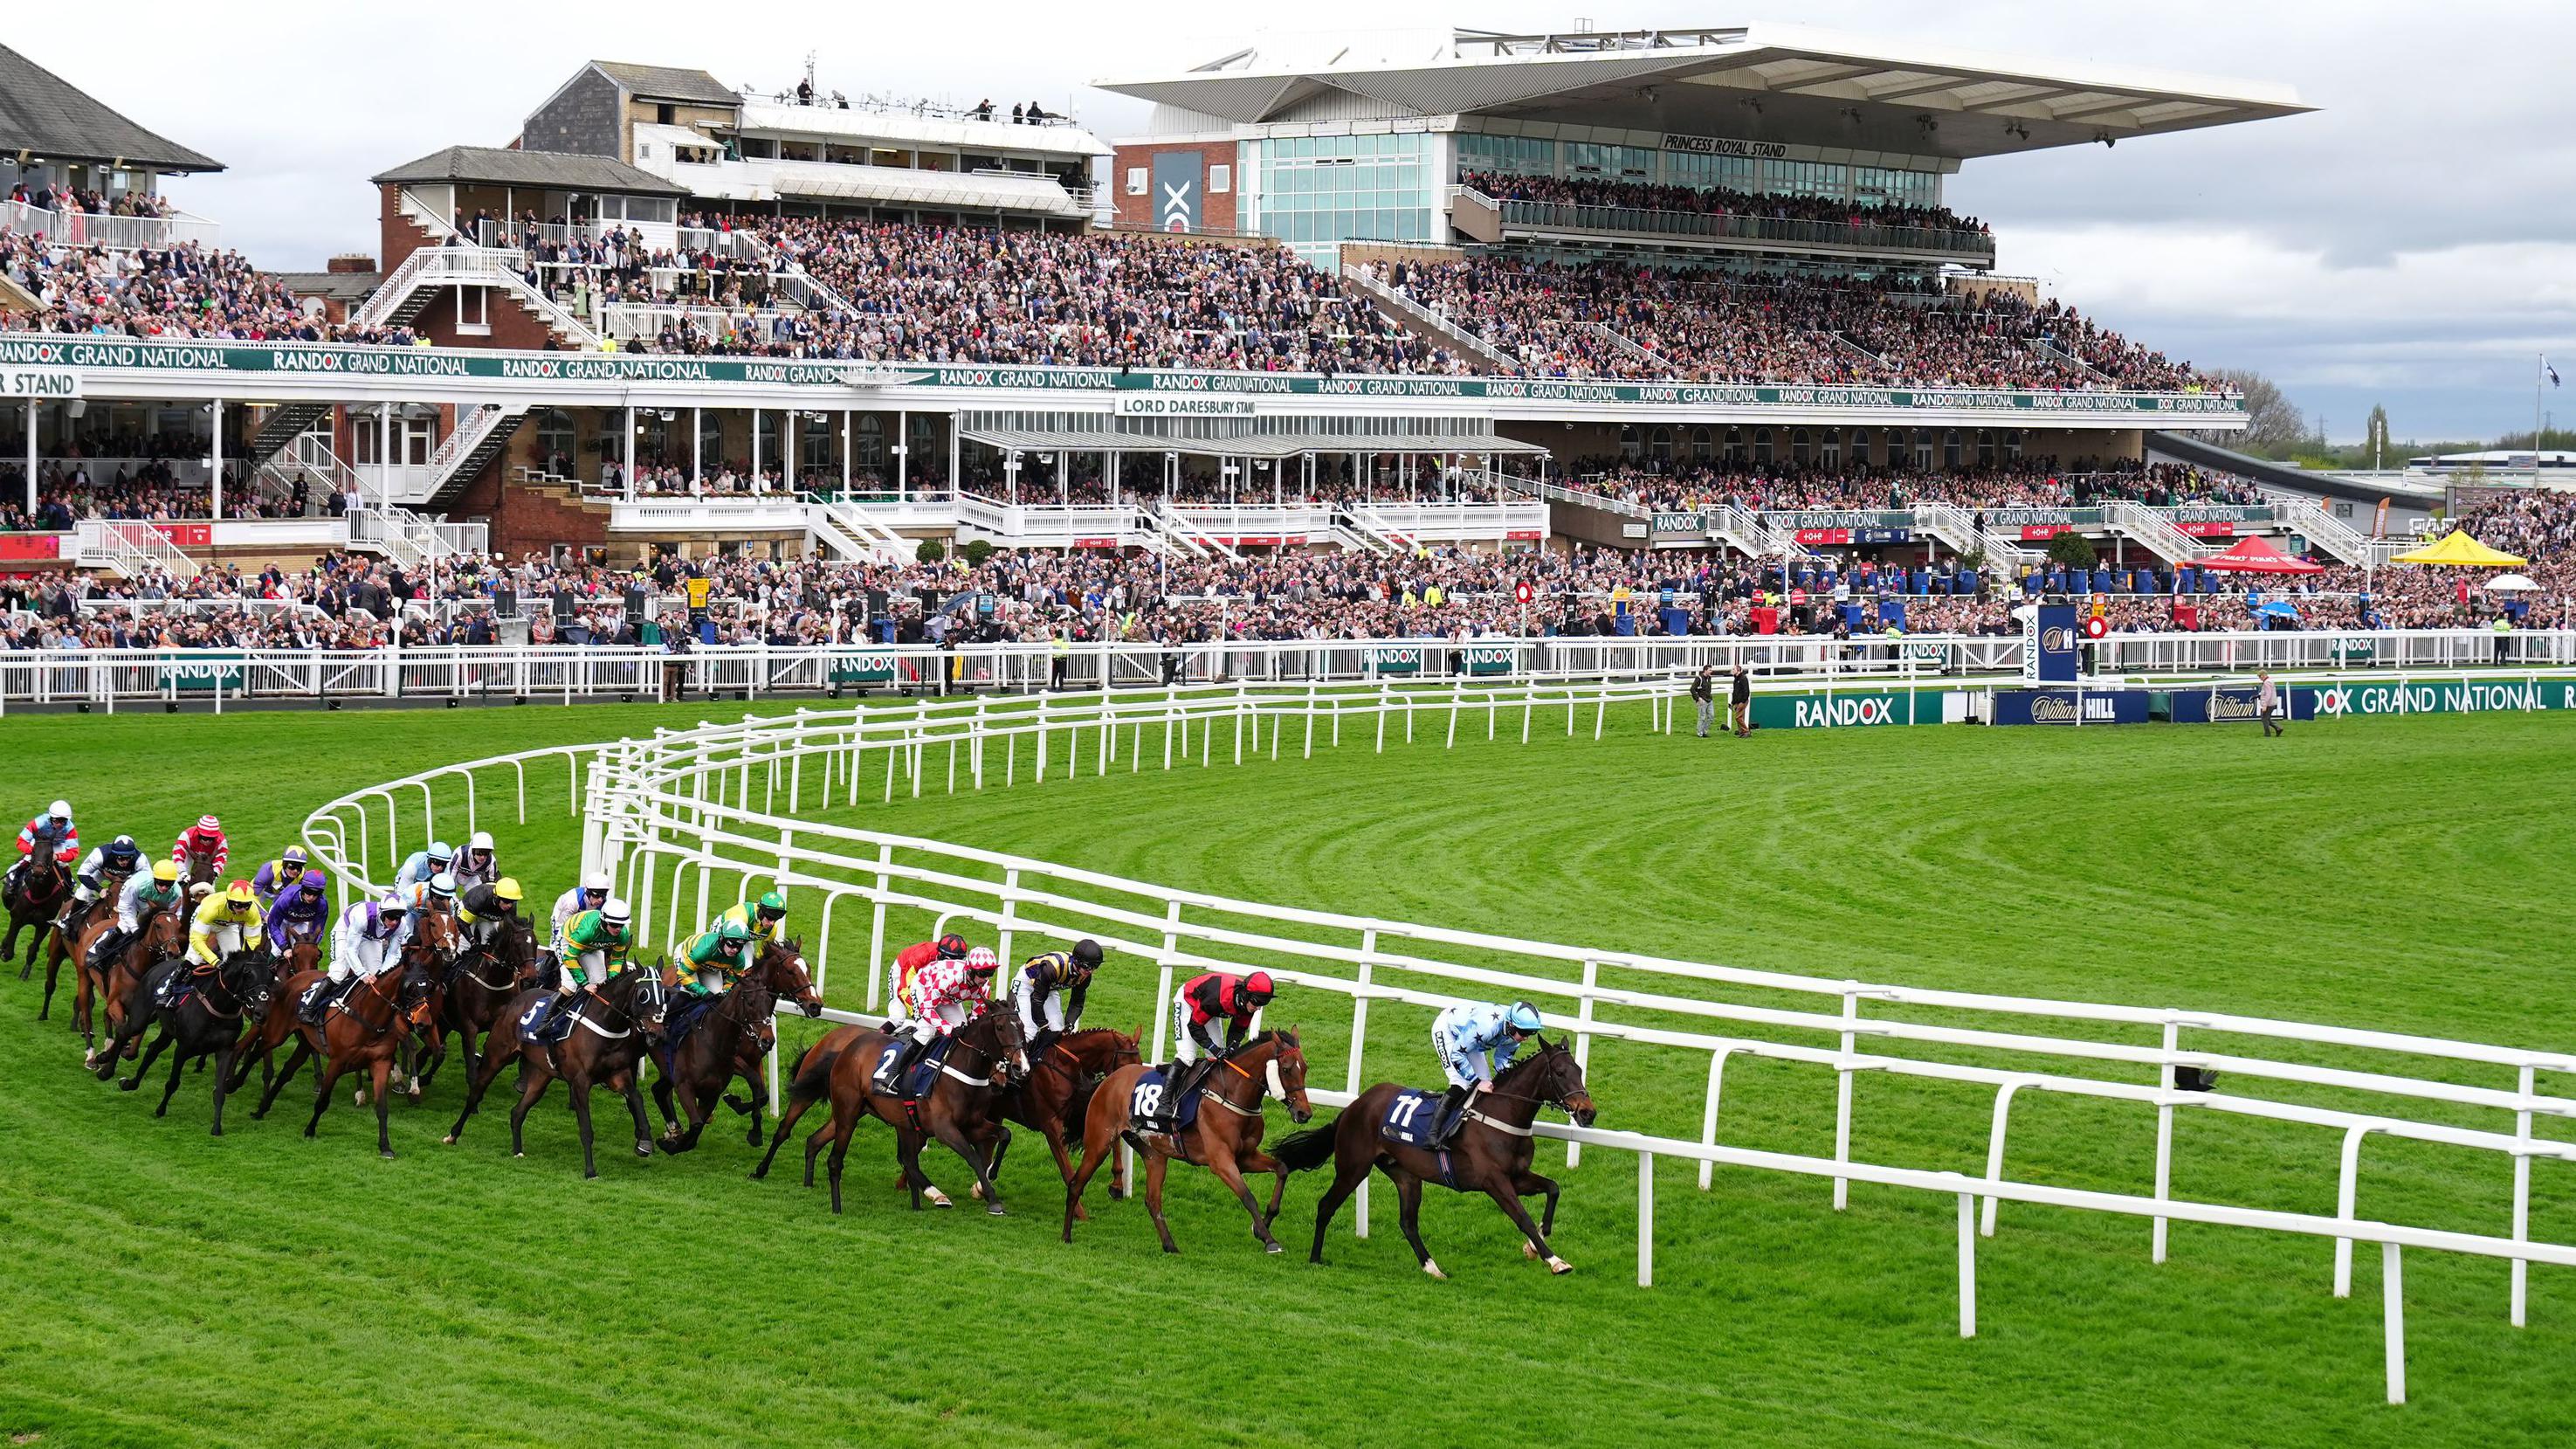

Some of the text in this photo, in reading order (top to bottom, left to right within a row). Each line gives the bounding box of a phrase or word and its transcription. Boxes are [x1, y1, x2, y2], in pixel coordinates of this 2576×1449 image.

[1664, 135, 1787, 158] PRINCESS ROYAL STAND
[72, 344, 135, 366] GRAND
[141, 348, 229, 368] NATIONAL
[273, 352, 469, 376] RANDOX GRAND NATIONAL
[503, 360, 711, 380] RANDOX GRAND NATIONAL
[746, 364, 787, 382] RANDOX
[790, 366, 836, 383] GRAND
[940, 370, 1115, 388] RANDOX GRAND NATIONAL
[15, 373, 74, 395] STAND
[1153, 374, 1292, 393] RANDOX GRAND NATIONAL
[1318, 380, 1462, 396] RANDOX GRAND NATIONAL
[1485, 383, 1618, 400] RANDOX GRAND NATIONAL
[1640, 388, 1678, 401] RANDOX
[1683, 388, 1725, 402] GRAND
[1779, 390, 1893, 404] RANDOX GRAND NATIONAL
[1912, 395, 1954, 406] RANDOX
[1976, 395, 2015, 407] NATIONAL
[2033, 396, 2139, 410] RANDOX GRAND NATIONAL
[1124, 399, 1256, 414] LORD DARESBURY STAND
[2158, 398, 2238, 411] DOX GRAND NATIONAL
[1656, 516, 1699, 530] RANDOX
[1765, 514, 1882, 528] NDOX GRAND NATIONAL
[2000, 512, 2029, 525] GRAND
[2032, 512, 2072, 524] NATIONAL
[2180, 509, 2207, 521] GRAND
[2208, 508, 2245, 521] NATIONAL
[1902, 644, 1946, 657] ANDOX
[2026, 615, 2035, 680] RANDOX
[830, 657, 895, 673] RANDOX
[2361, 687, 2436, 713] GRAND
[2445, 685, 2547, 711] NATIONAL
[1795, 697, 1894, 727] RANDOX
[2032, 696, 2115, 721] William HILL
[1436, 1031, 1450, 1068] RANDOX
[873, 1049, 897, 1079] 2
[1134, 1083, 1163, 1118] 18
